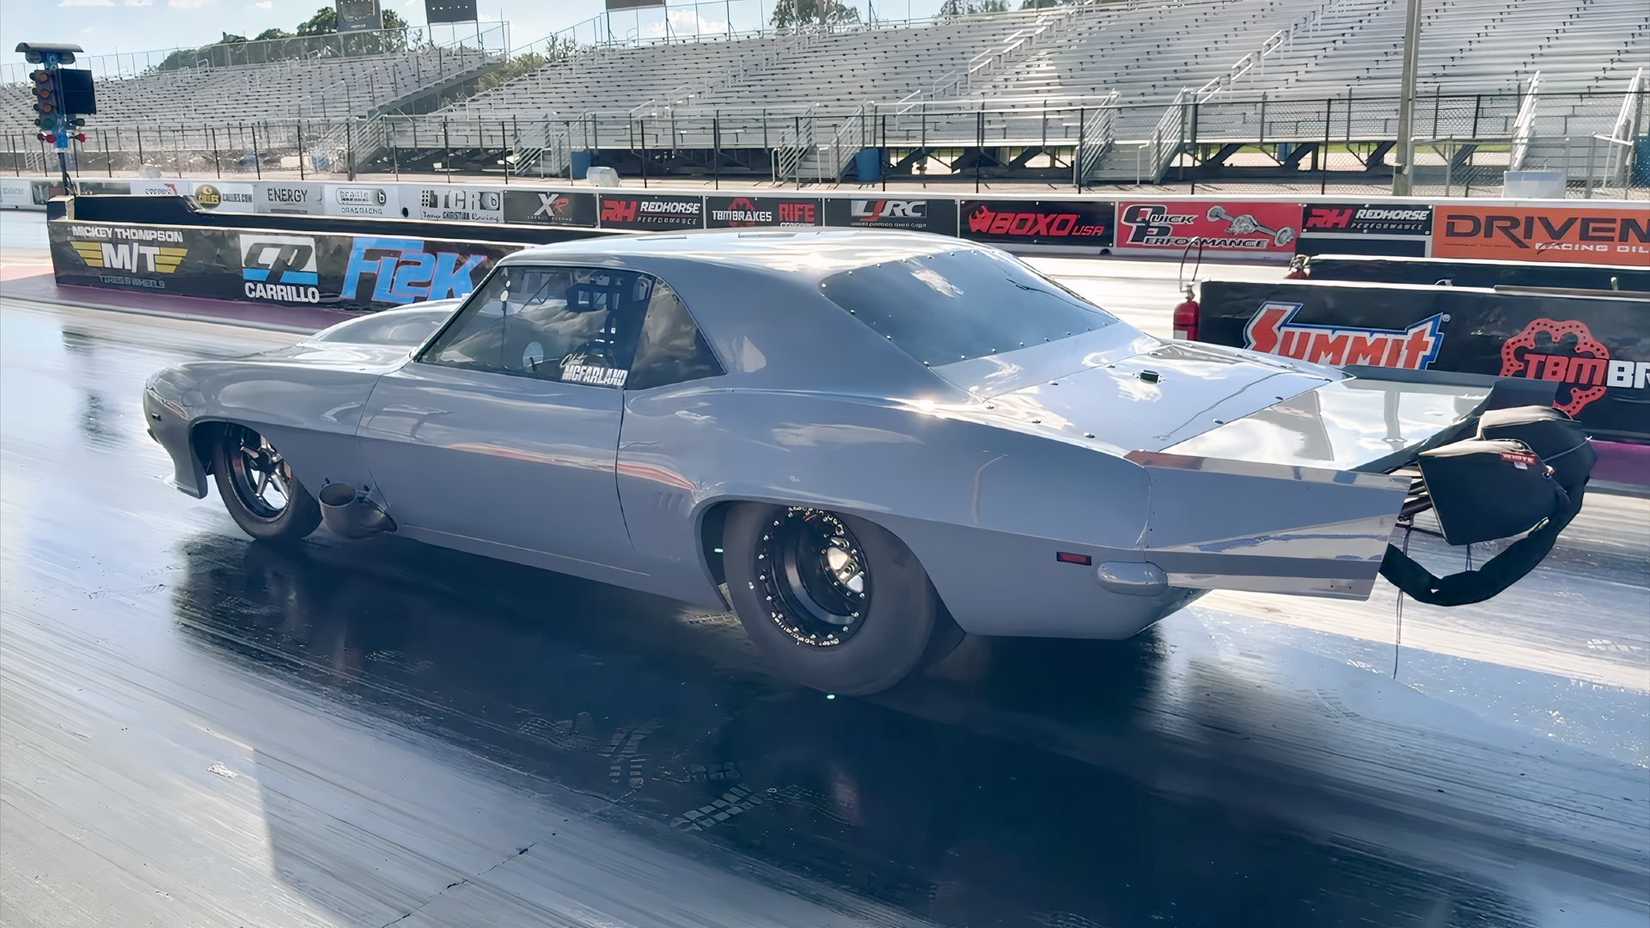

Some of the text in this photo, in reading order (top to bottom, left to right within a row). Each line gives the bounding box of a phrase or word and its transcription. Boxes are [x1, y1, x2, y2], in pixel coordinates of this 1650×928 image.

[267, 188, 308, 202] ENERGY
[640, 201, 700, 214] REDHORSE
[778, 203, 816, 222] RIFE
[1121, 204, 1198, 226] QUICK
[1355, 209, 1431, 221] REDHORSE
[71, 225, 184, 242] MICKEY THOMPSON
[990, 212, 1105, 236] BOXO USA
[1445, 214, 1650, 249] DRIVEN
[101, 242, 160, 273] M/T
[1616, 244, 1650, 254] OIL
[244, 282, 320, 304] CARRILLO
[562, 365, 629, 386] MCFARLAND
